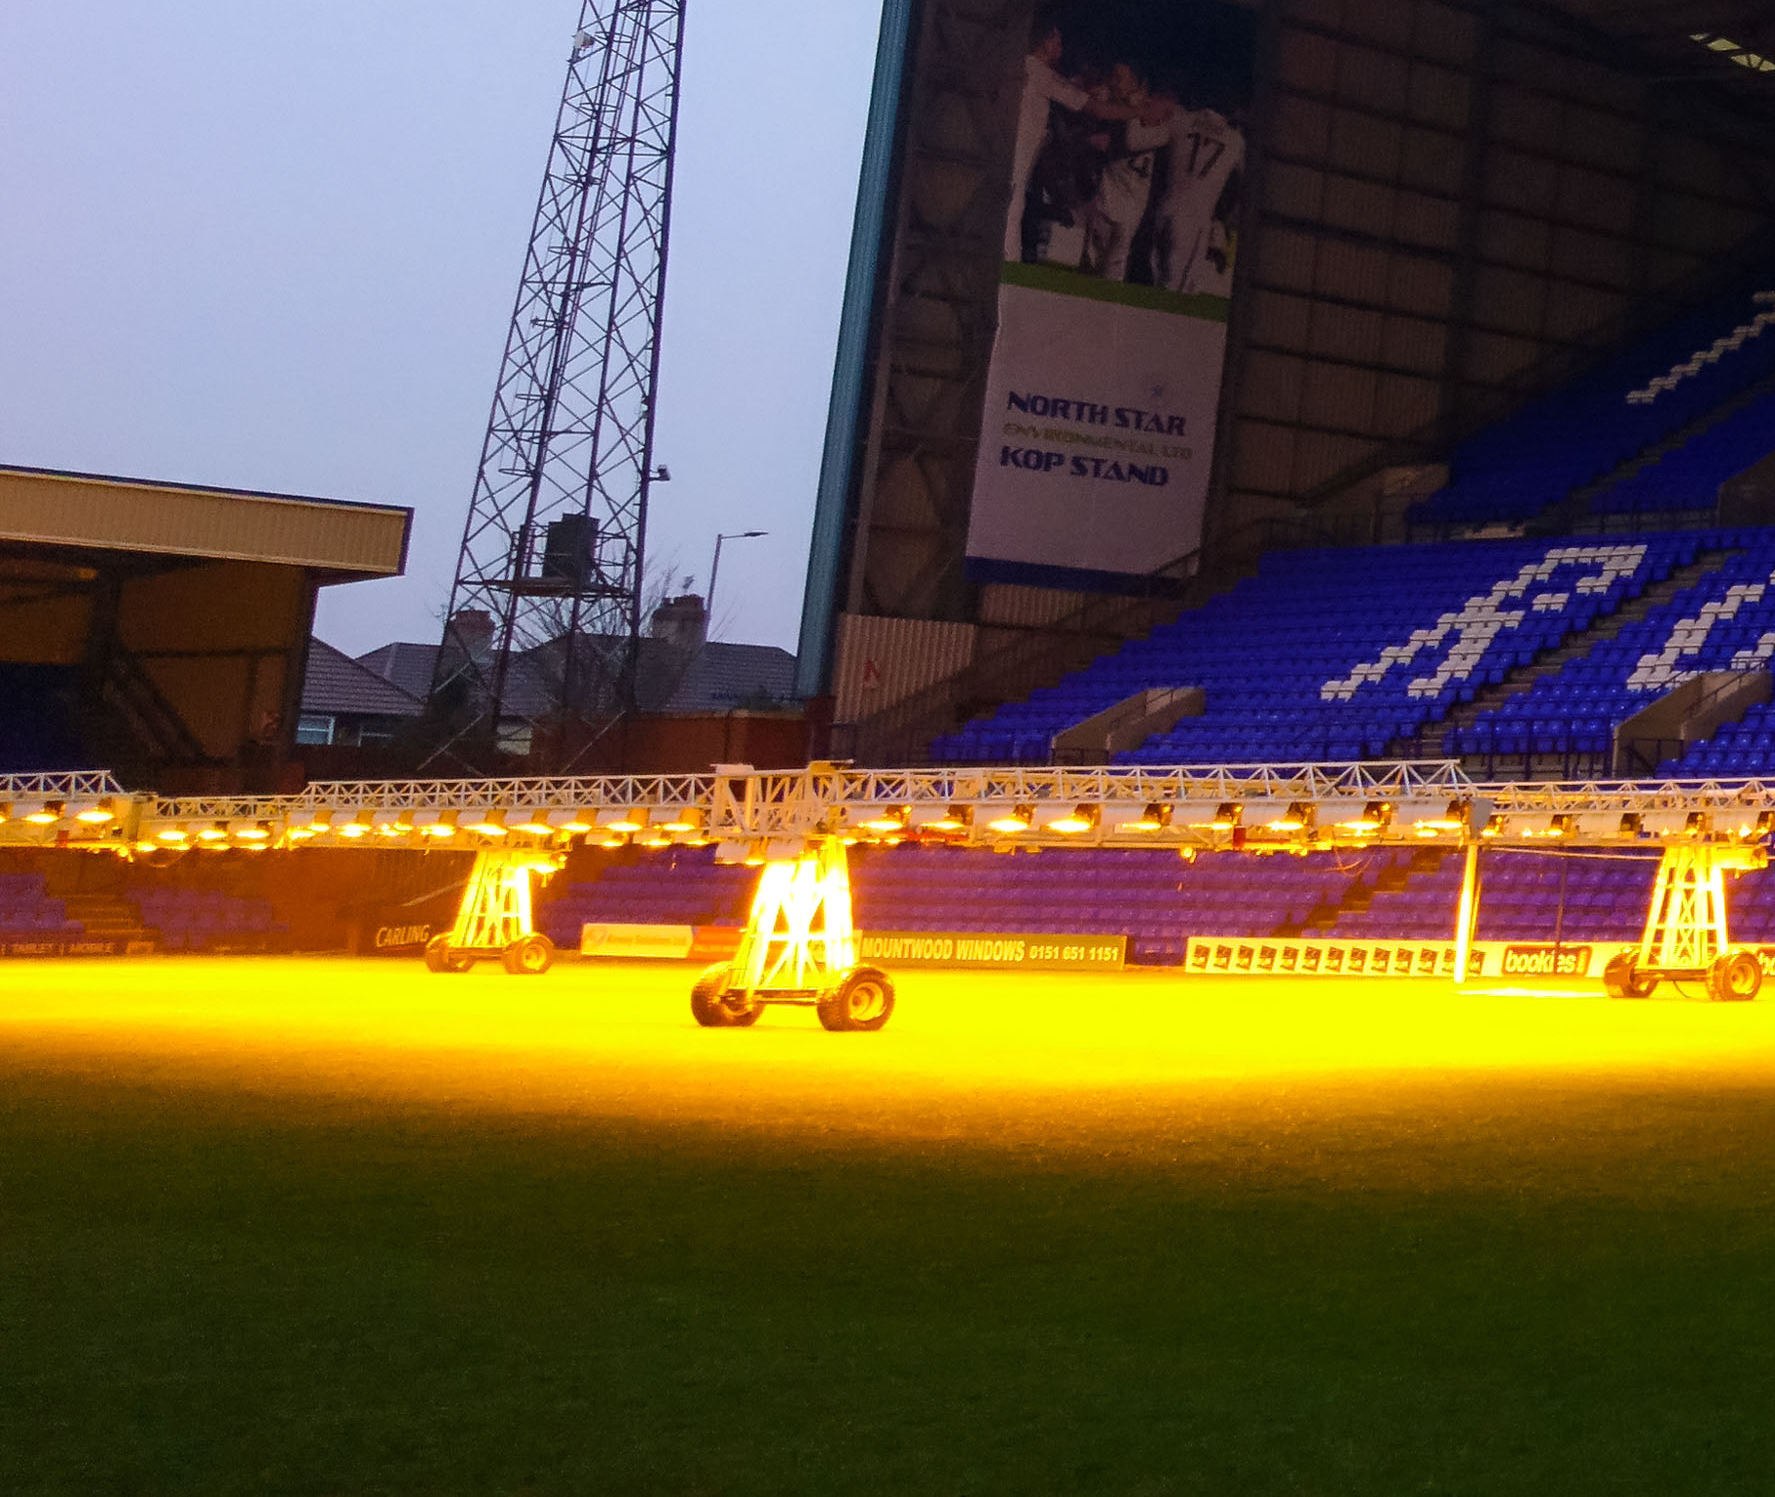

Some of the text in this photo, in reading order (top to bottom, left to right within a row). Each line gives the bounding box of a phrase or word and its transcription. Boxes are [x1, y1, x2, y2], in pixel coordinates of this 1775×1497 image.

[1007, 390, 1187, 437] NORTH STAR
[999, 445, 1170, 487] KOP STAND
[862, 937, 1119, 962] MOUNTWOOD WINDOWS 0151 651 1151
